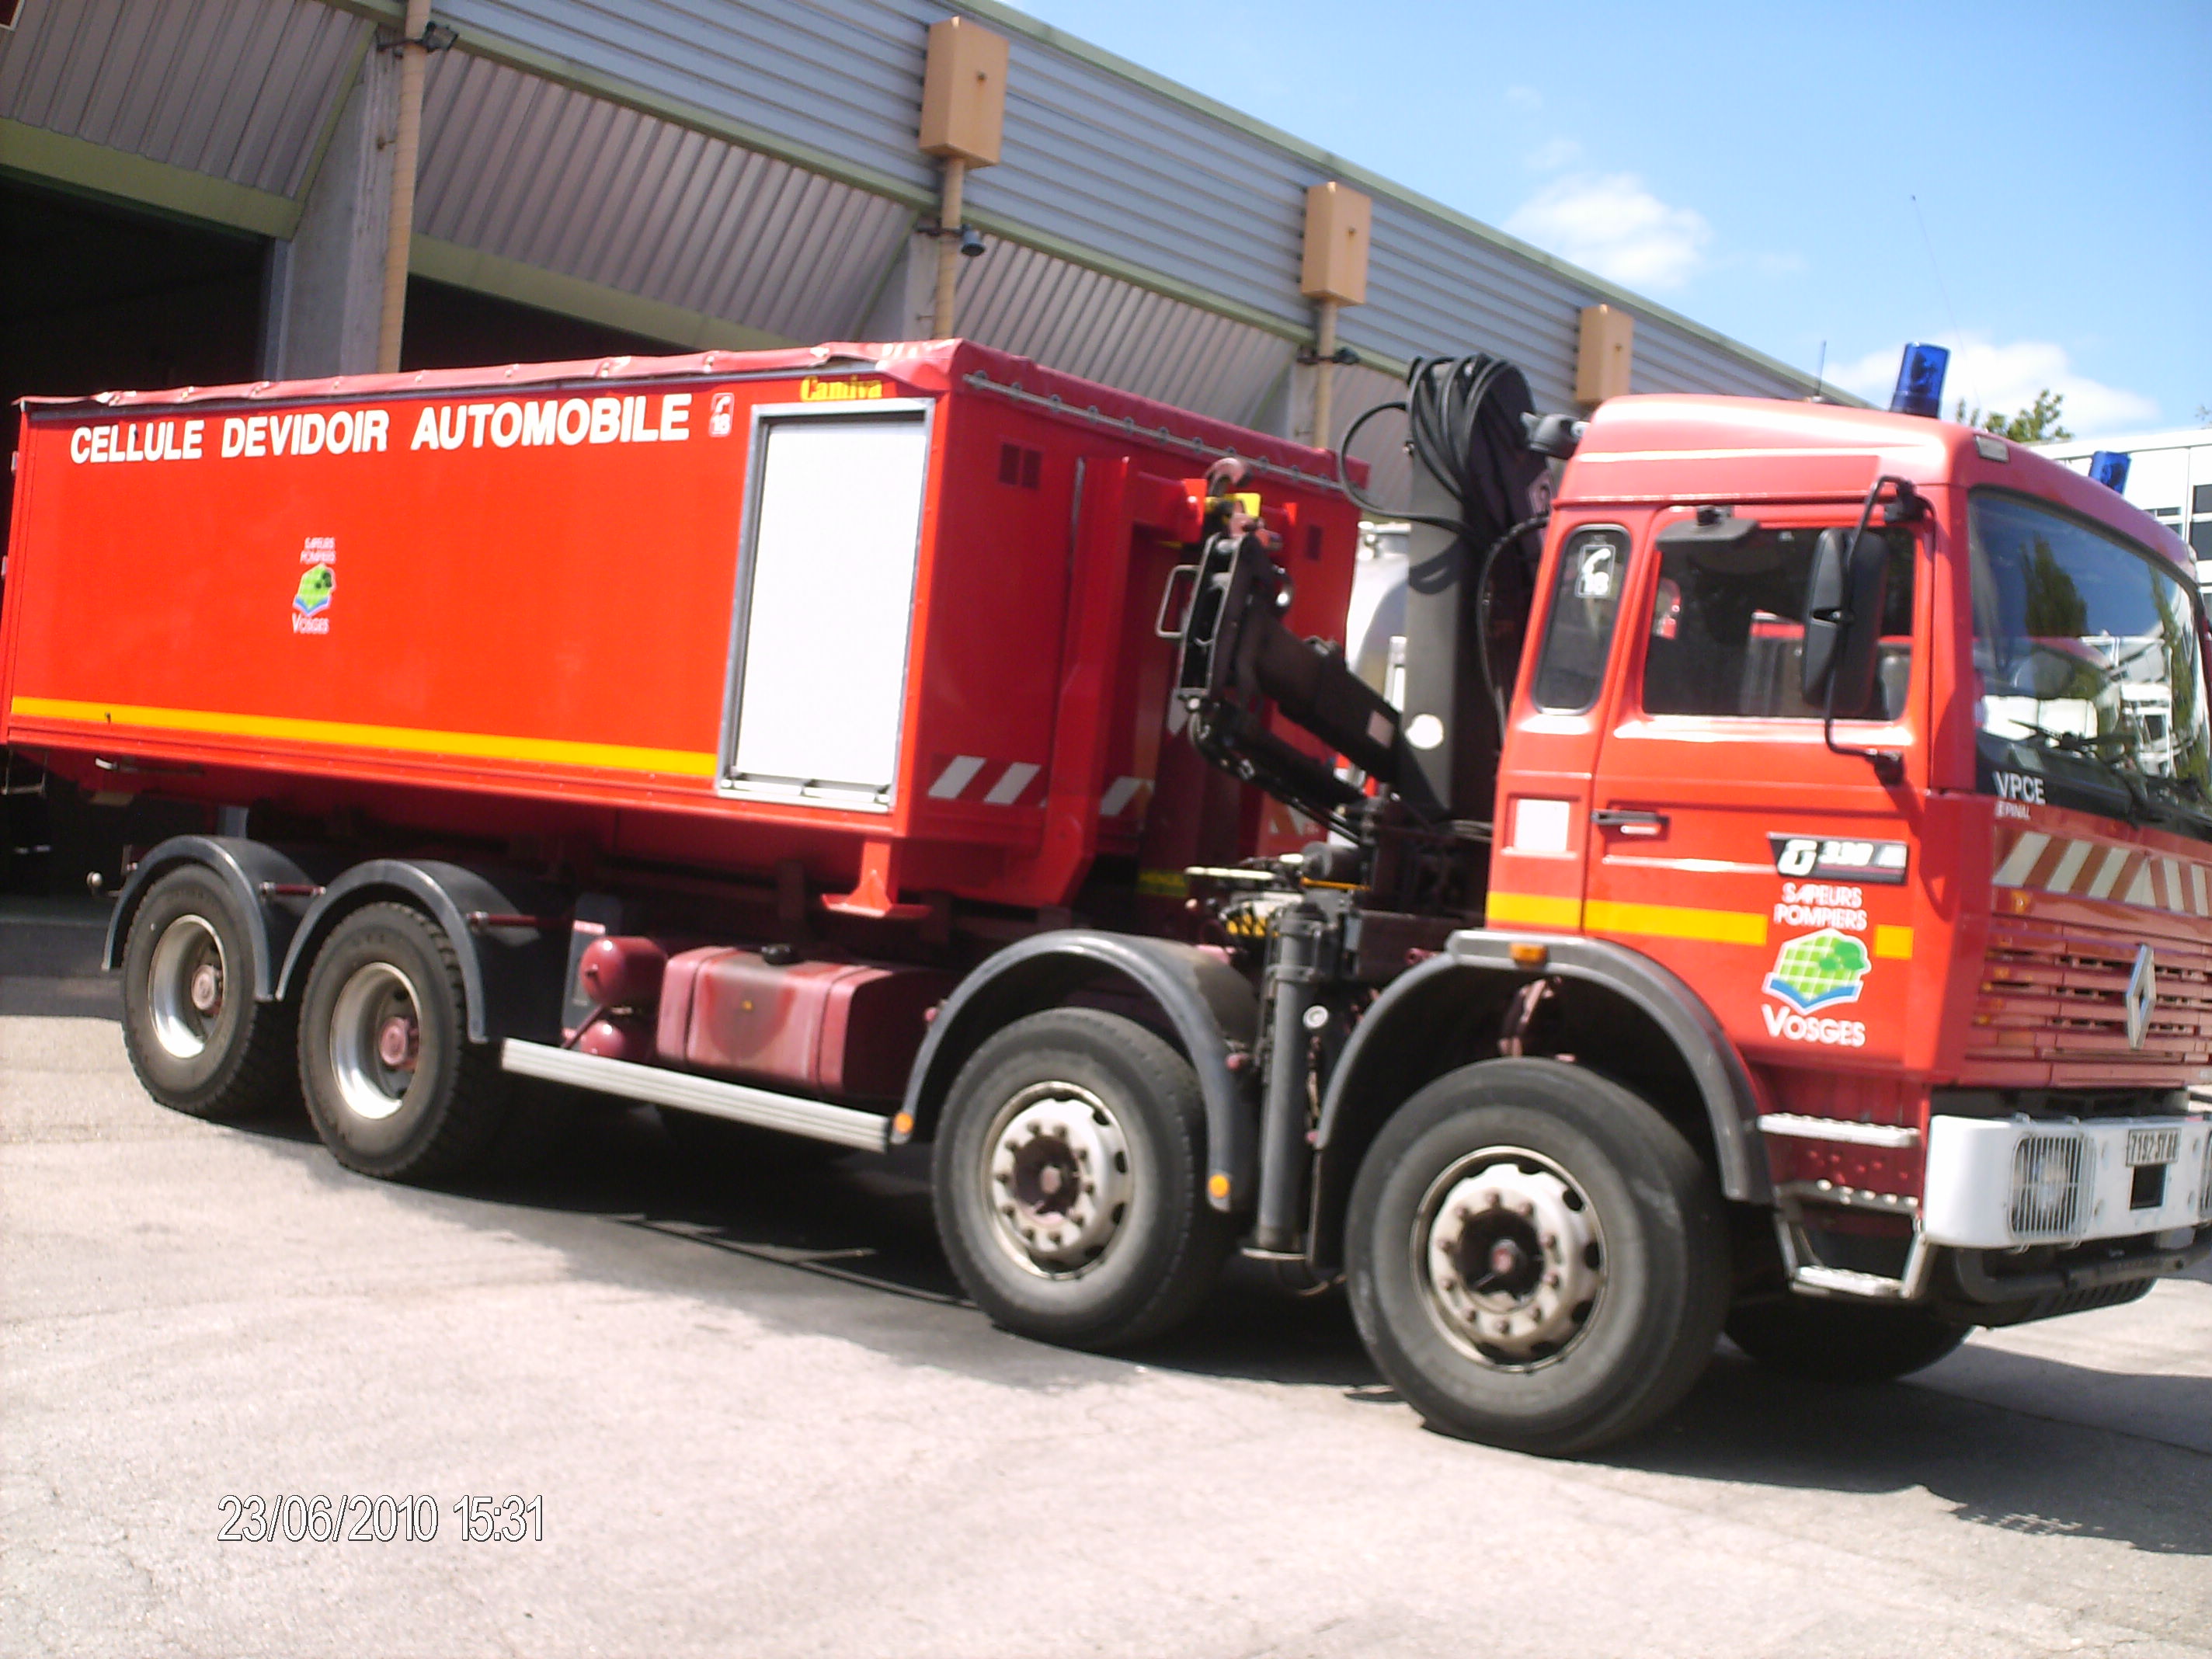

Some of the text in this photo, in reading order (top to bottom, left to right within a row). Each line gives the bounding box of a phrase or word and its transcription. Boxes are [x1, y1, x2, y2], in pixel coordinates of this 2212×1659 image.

[800, 374, 882, 402] Camiva
[71, 393, 693, 464] CELLULE DEVIDOIR AUTOMOBILE
[711, 412, 731, 435] 18
[1583, 572, 1610, 596] 18
[1991, 770, 2046, 806] VPCE
[1995, 800, 2030, 820] EPINAL
[1781, 882, 1864, 909] SAPEURS
[1773, 903, 1868, 931] POMPIERS
